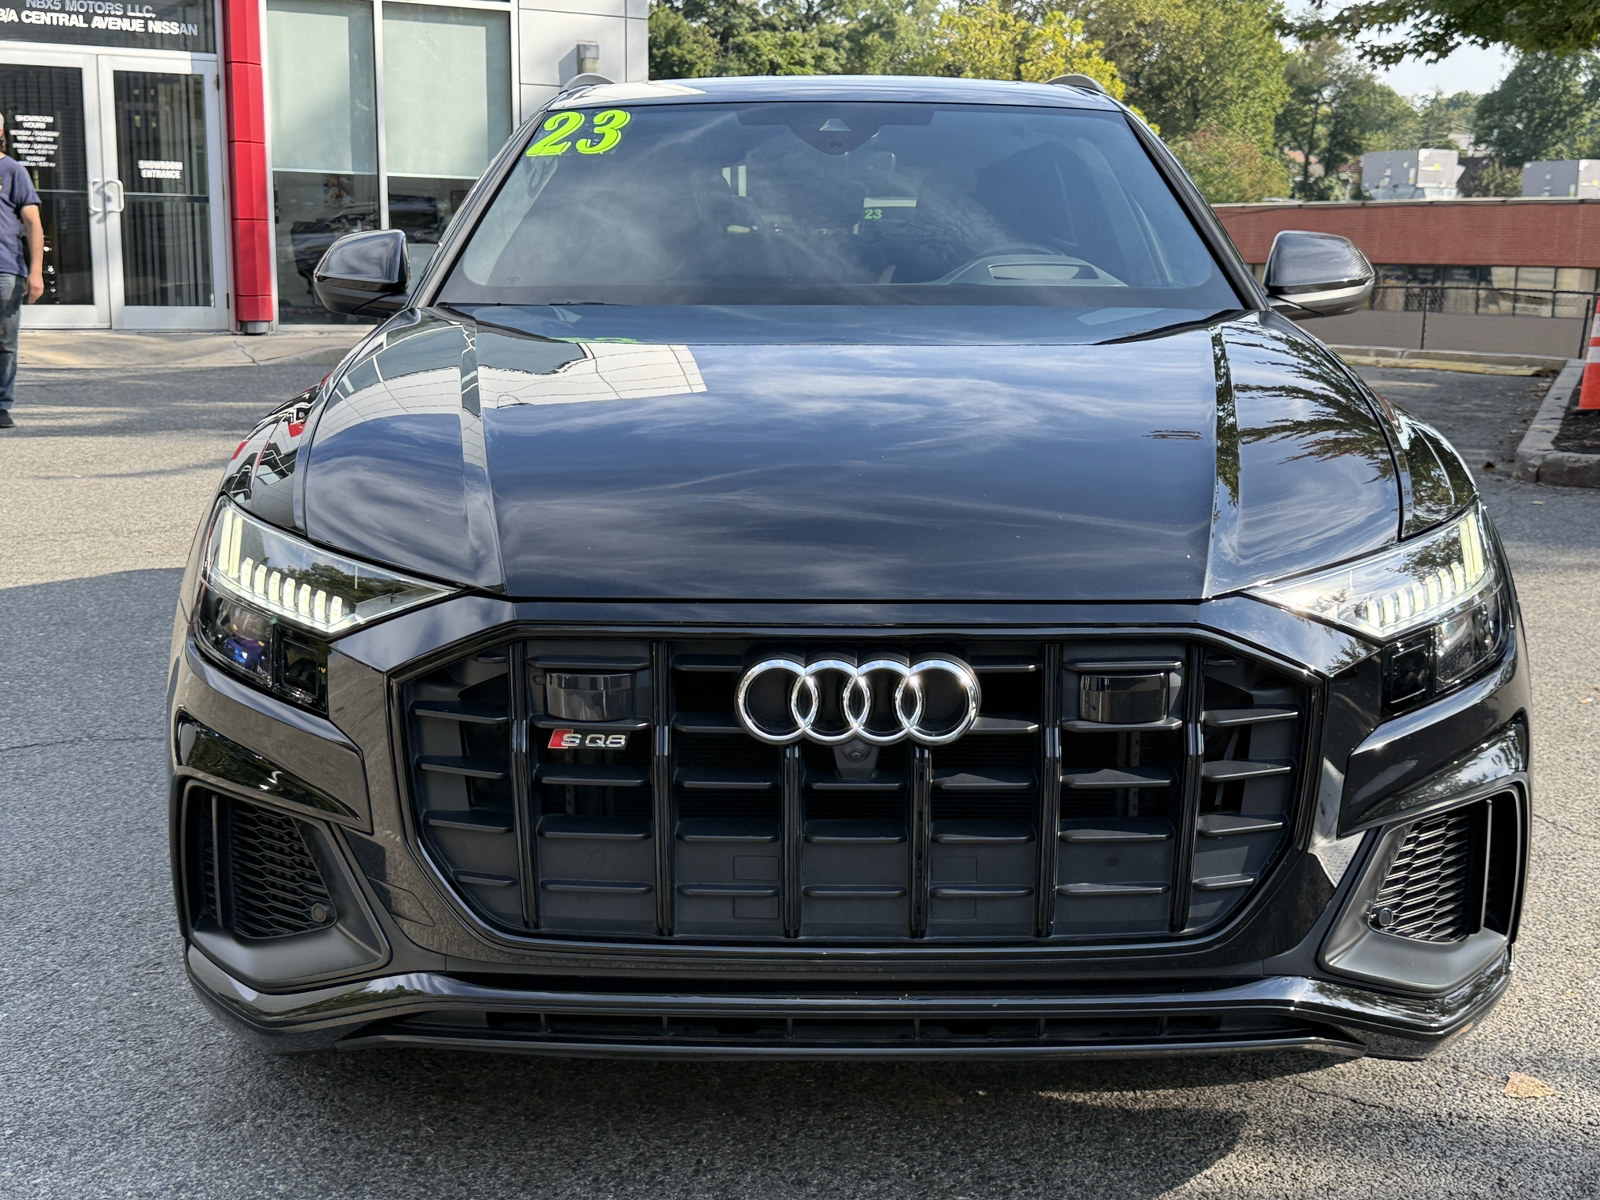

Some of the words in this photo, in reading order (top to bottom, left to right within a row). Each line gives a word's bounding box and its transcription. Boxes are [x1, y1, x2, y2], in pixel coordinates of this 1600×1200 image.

[25, 0, 62, 10] NBX5
[65, 0, 124, 15] MOTORS
[126, 3, 156, 18] LLC.
[21, 10, 89, 28] CENTRAL
[90, 15, 145, 32] AVENUE
[148, 19, 198, 36] NISSAN
[525, 109, 631, 157] 23
[137, 159, 183, 170] SHOWROOM
[140, 169, 181, 179] ENTRANCE
[864, 208, 882, 220] 23
